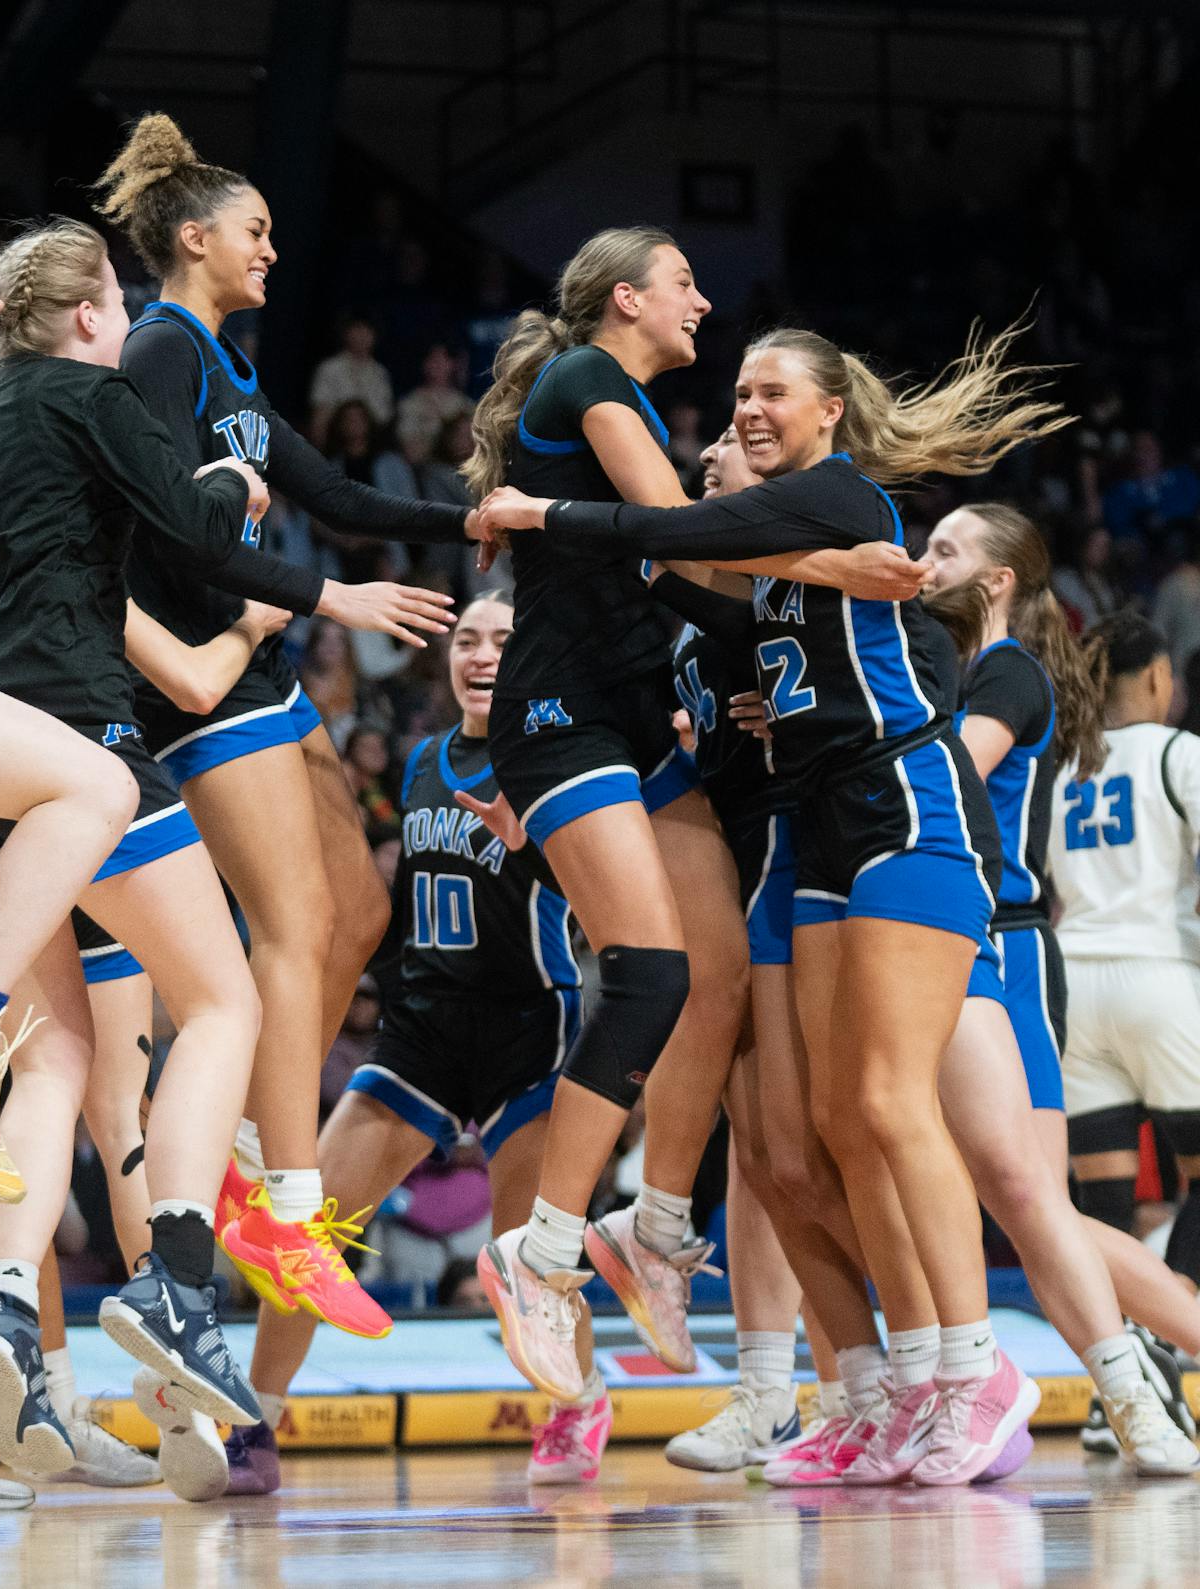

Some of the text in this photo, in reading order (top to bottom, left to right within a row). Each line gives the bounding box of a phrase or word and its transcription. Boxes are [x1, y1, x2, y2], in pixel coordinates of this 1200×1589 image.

[753, 576, 806, 625] KA
[524, 697, 573, 735] M
[755, 635, 817, 724] 2
[1064, 774, 1136, 851] 23
[413, 871, 478, 949] 10
